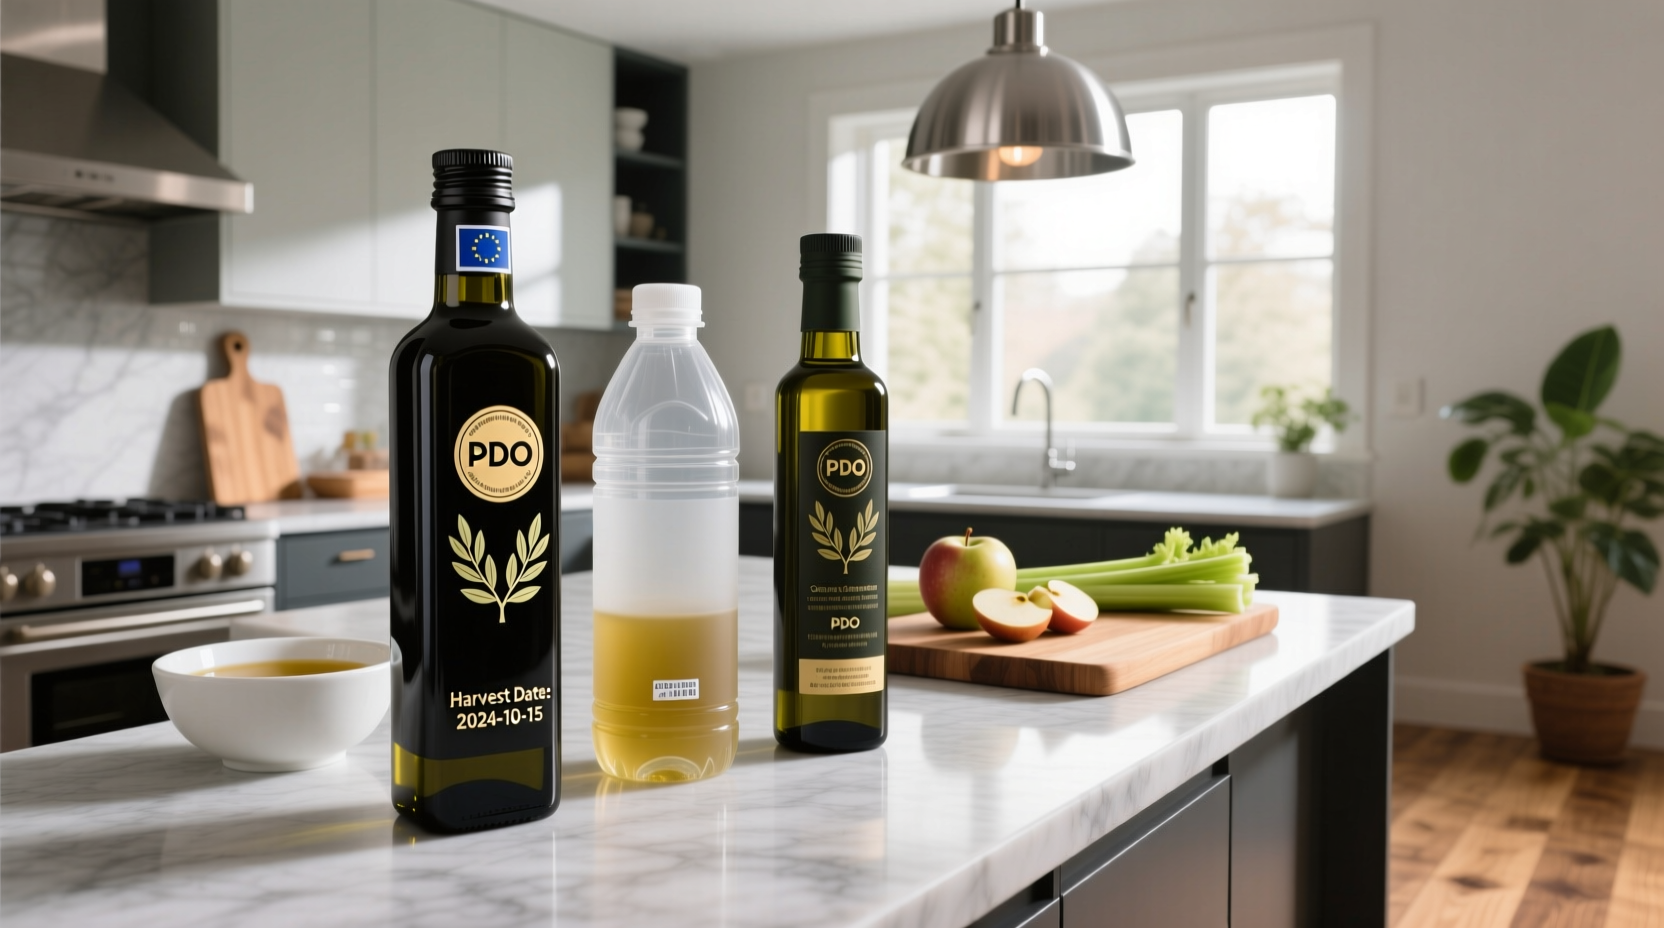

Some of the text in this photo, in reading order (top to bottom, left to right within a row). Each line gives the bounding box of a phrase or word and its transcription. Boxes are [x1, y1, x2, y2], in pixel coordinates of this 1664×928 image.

[468, 440, 533, 467] PDO
[826, 458, 866, 477] PDO
[831, 616, 860, 630] PDO
[450, 686, 551, 708] Harvest Date:
[456, 705, 544, 730] 2024-10-15
